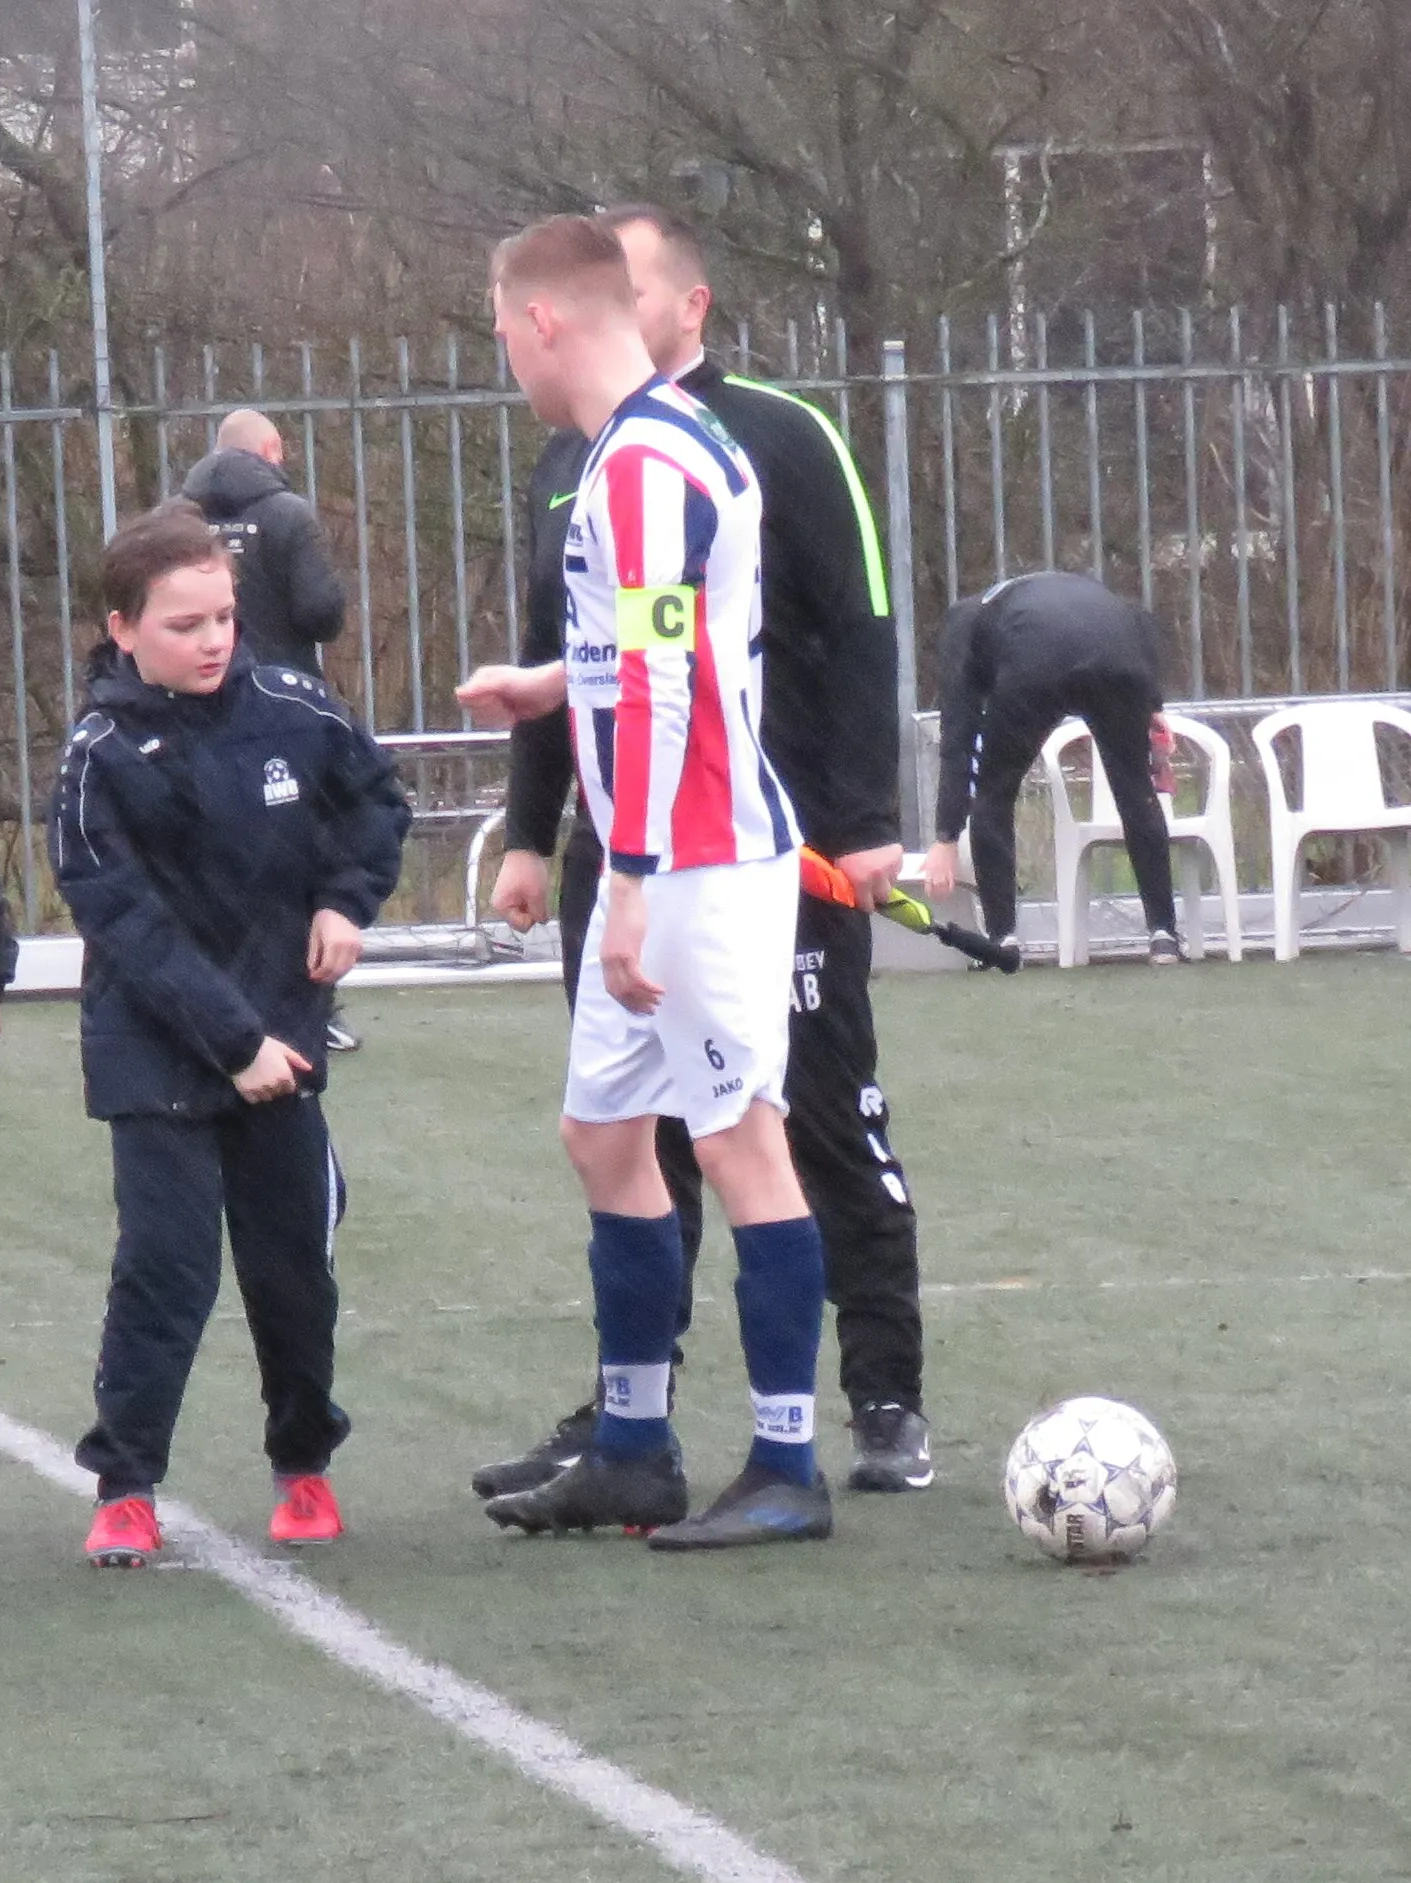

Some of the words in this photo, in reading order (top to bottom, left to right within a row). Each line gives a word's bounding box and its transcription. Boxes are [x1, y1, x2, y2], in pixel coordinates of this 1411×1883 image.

[652, 594, 685, 638] C
[705, 1039, 725, 1071] 6
[712, 1077, 744, 1099] JAKO
